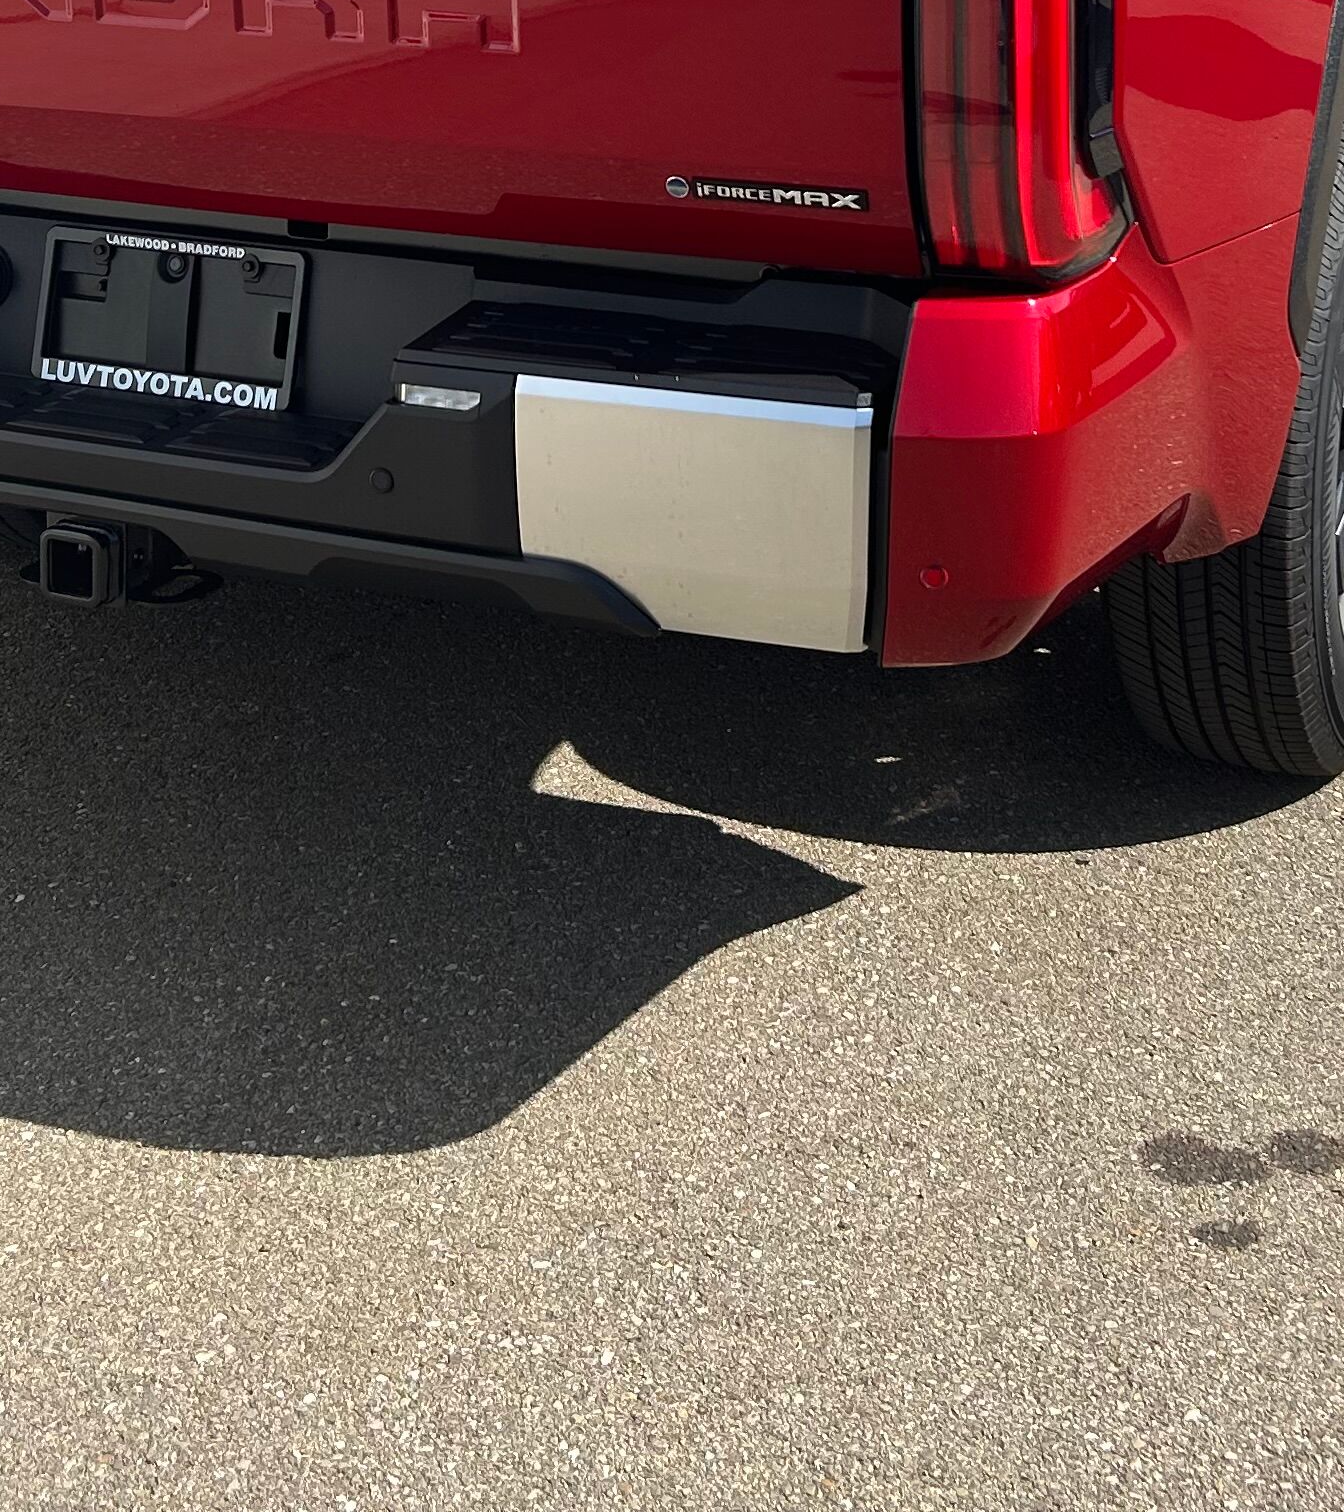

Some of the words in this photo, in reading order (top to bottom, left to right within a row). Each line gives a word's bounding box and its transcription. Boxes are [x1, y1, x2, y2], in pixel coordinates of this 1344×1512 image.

[106, 234, 170, 251] LAKEWOOD
[178, 242, 246, 259] BRADFORD
[40, 358, 279, 412] LUVTOYOTA.COM
